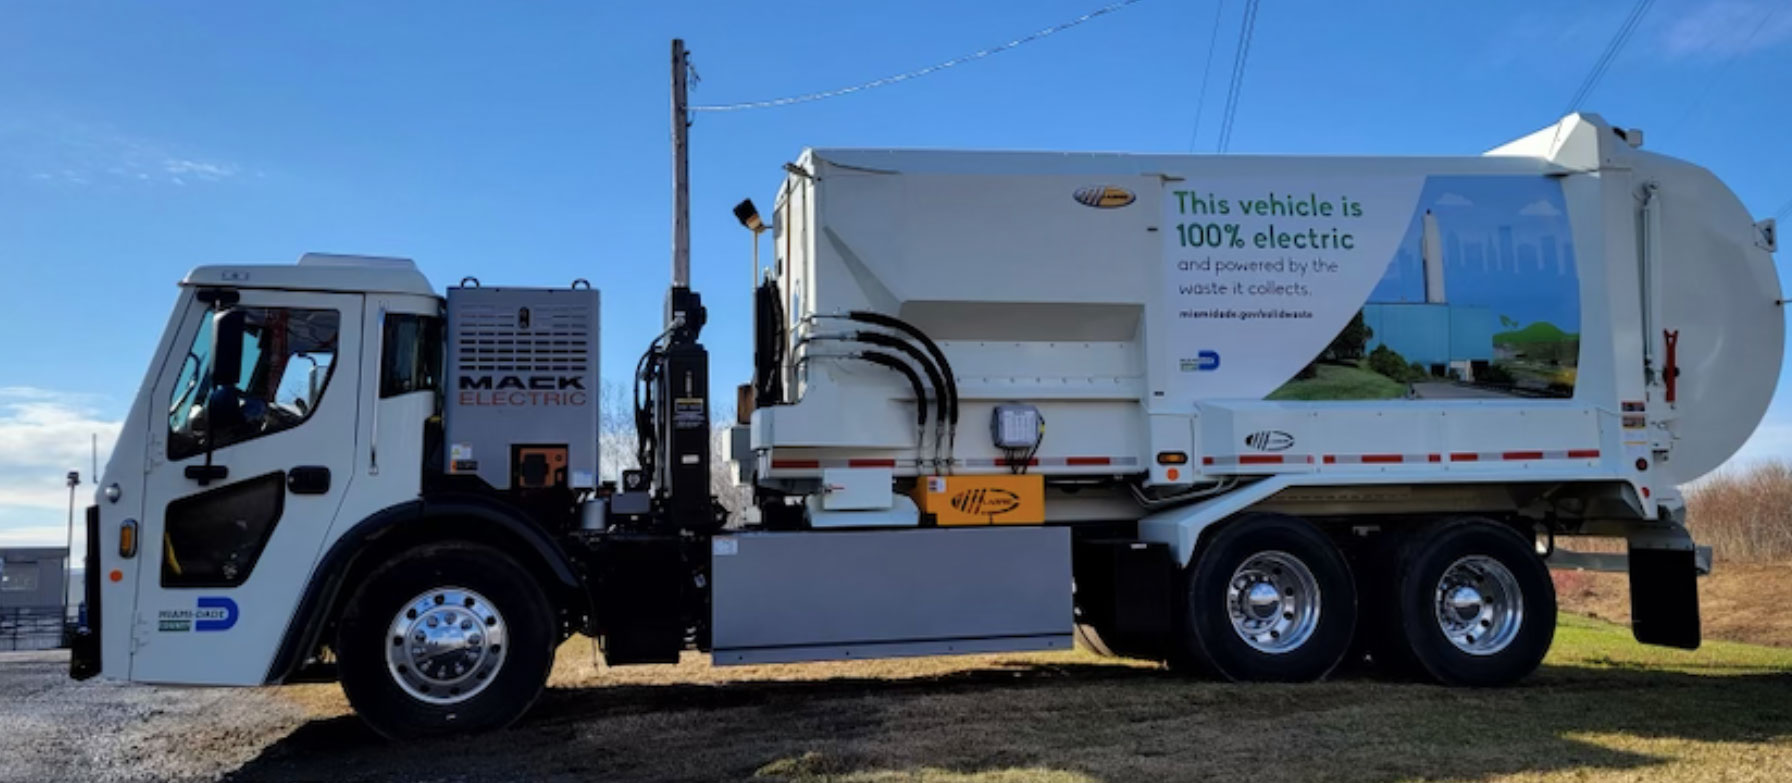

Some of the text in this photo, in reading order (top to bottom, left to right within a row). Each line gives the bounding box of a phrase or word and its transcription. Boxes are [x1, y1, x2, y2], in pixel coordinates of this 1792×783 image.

[1173, 191, 1363, 217] This vehicle is
[1176, 223, 1355, 250] 100% electric
[1177, 257, 1339, 276] and powered by the
[1178, 282, 1313, 296] waste it collects.
[459, 376, 586, 390] MACK
[459, 391, 586, 406] ELECTRIC
